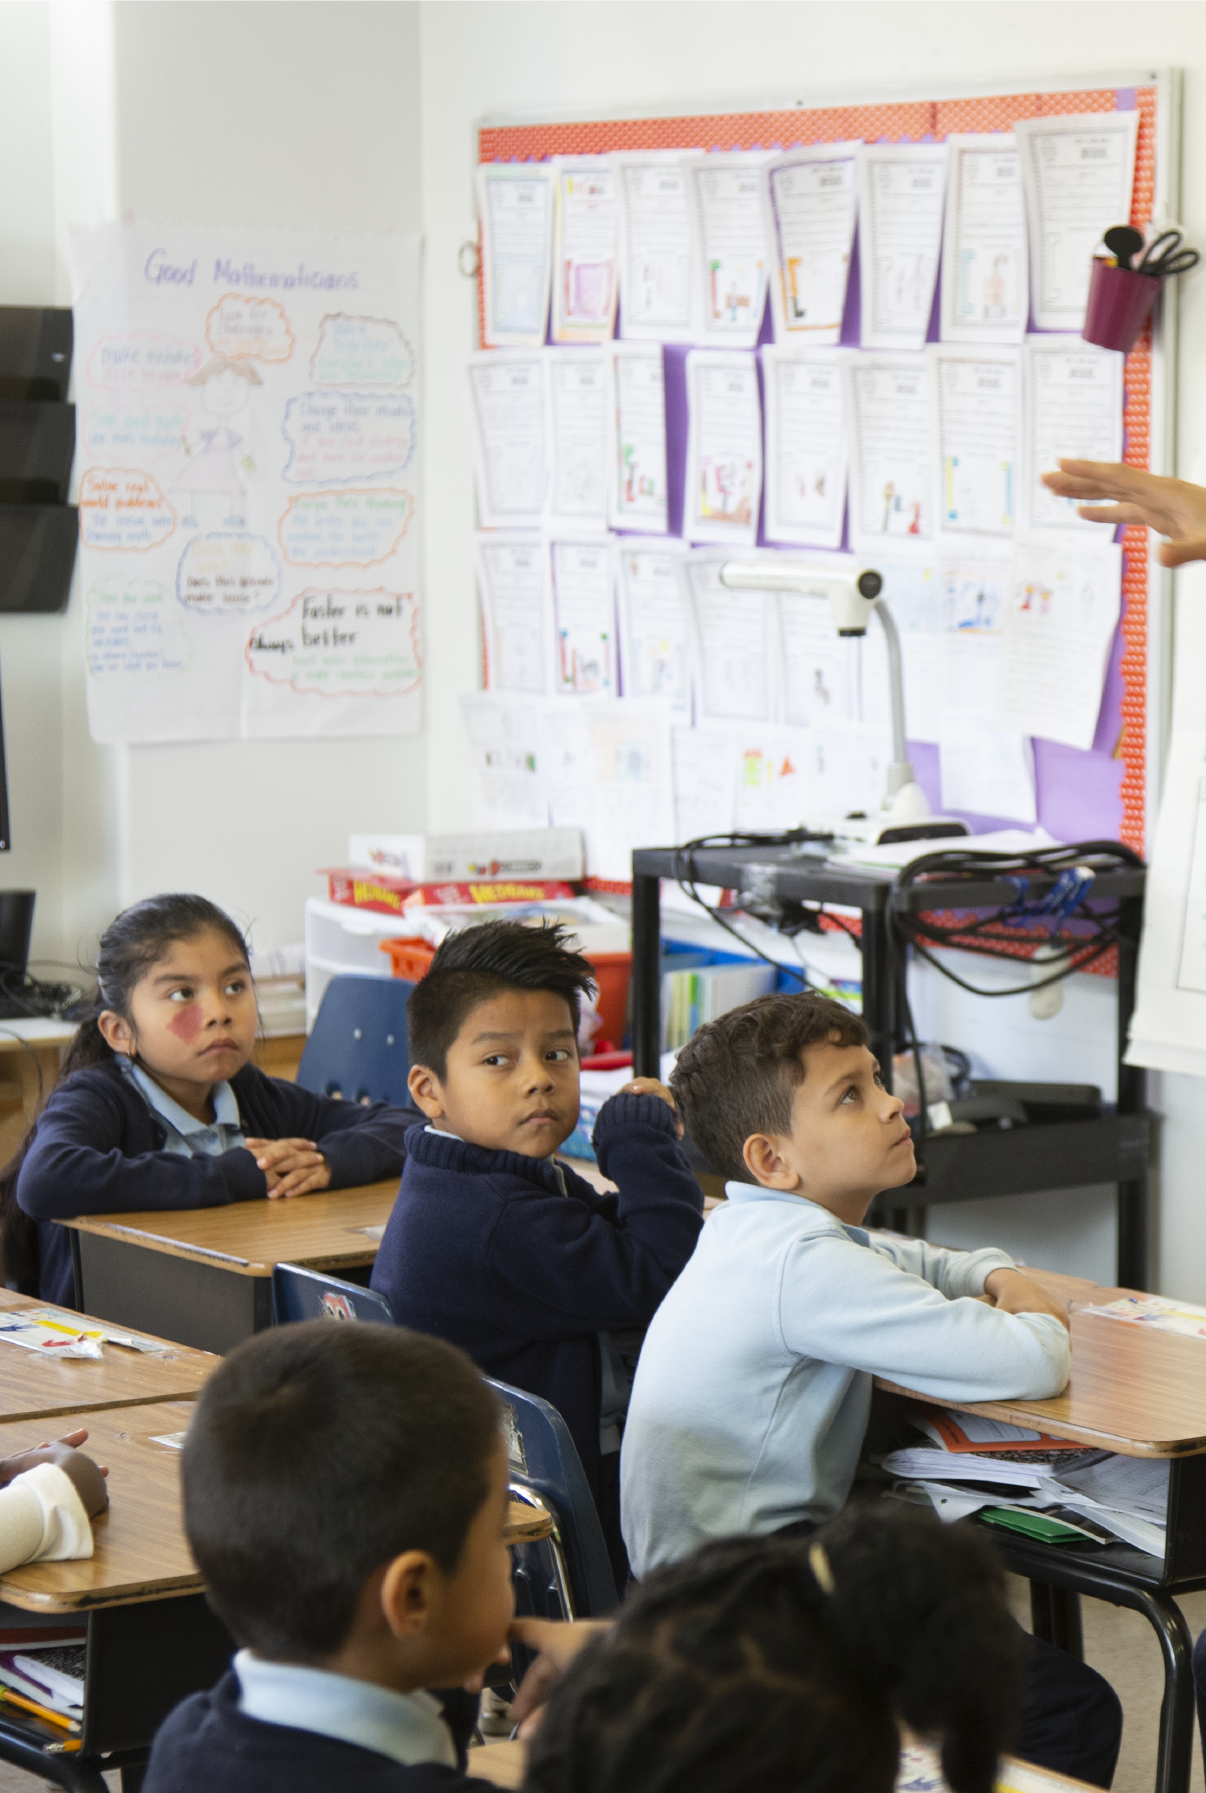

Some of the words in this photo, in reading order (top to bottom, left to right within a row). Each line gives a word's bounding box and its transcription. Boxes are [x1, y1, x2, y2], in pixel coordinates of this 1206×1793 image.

[144, 248, 197, 286] Good
[302, 593, 345, 620] Faster
[356, 603, 369, 618] is
[377, 593, 404, 620] not
[301, 622, 357, 649] better
